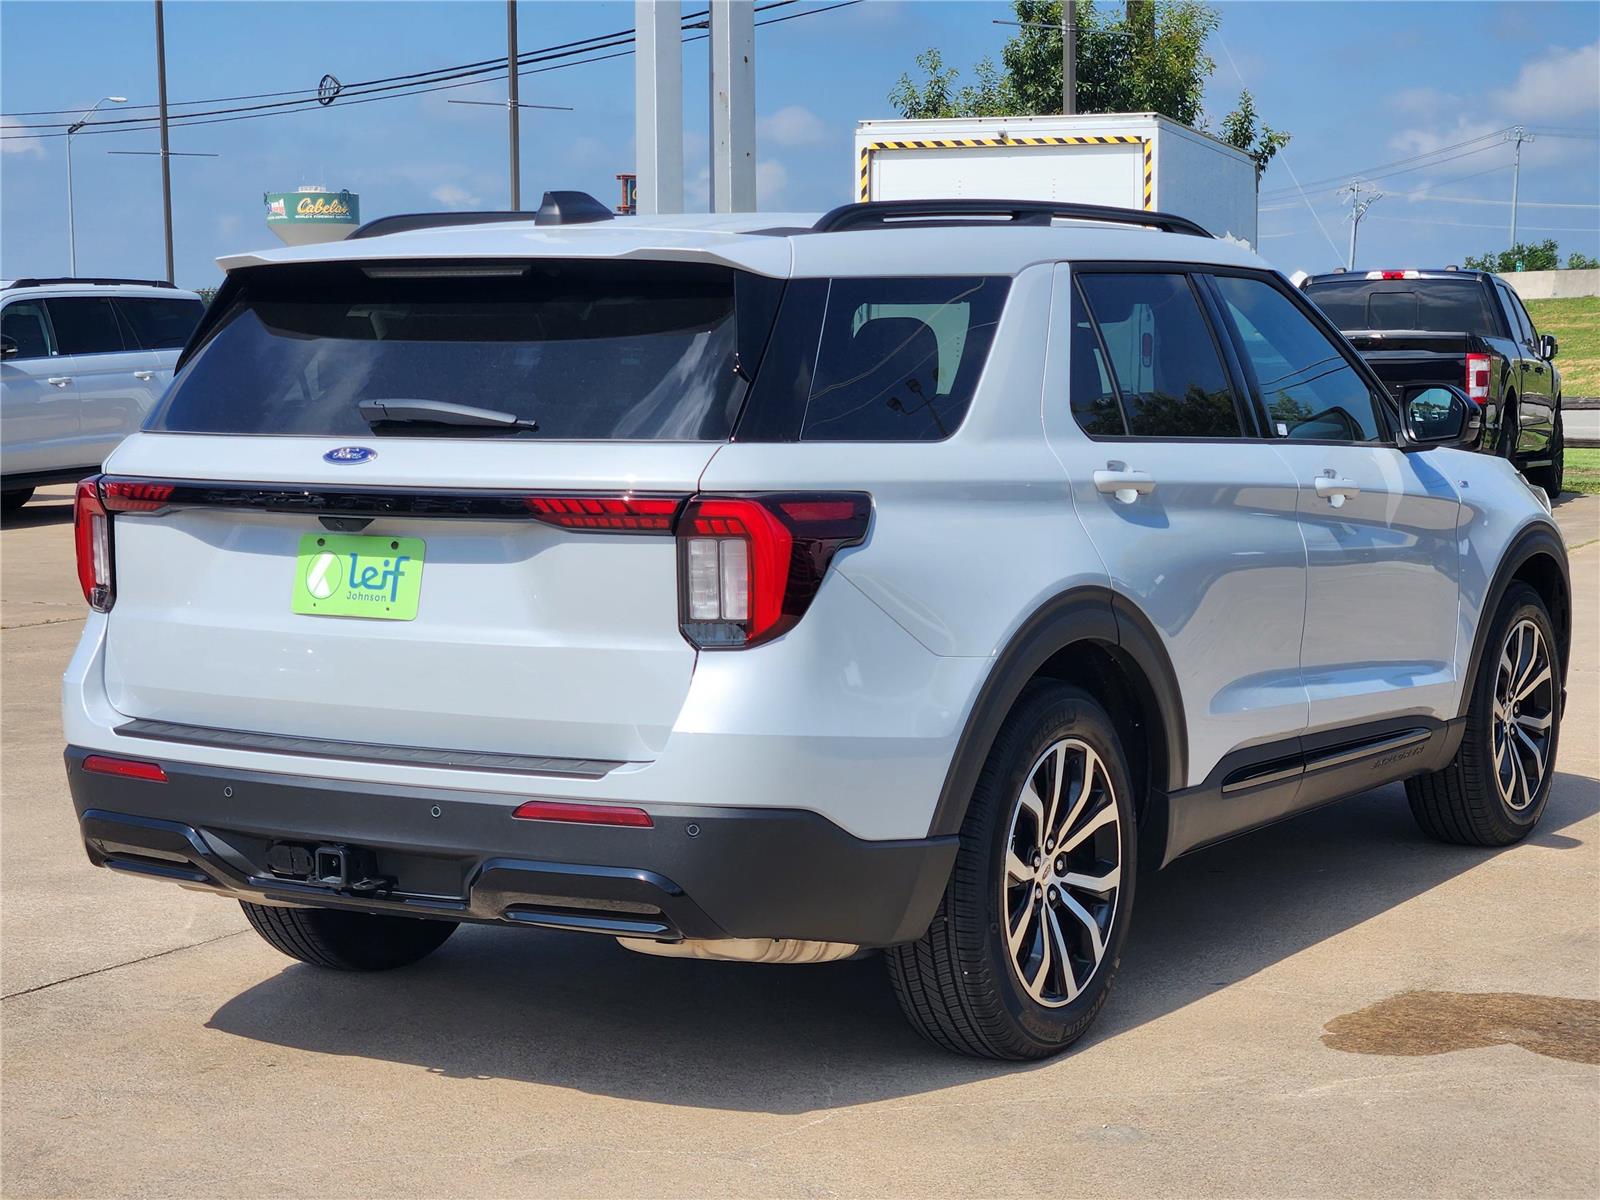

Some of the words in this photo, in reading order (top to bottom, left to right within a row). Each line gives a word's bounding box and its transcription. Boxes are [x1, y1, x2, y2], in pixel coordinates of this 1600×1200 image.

[332, 448, 364, 460] Ford
[349, 552, 410, 603] leif
[346, 590, 387, 602] Johnson
